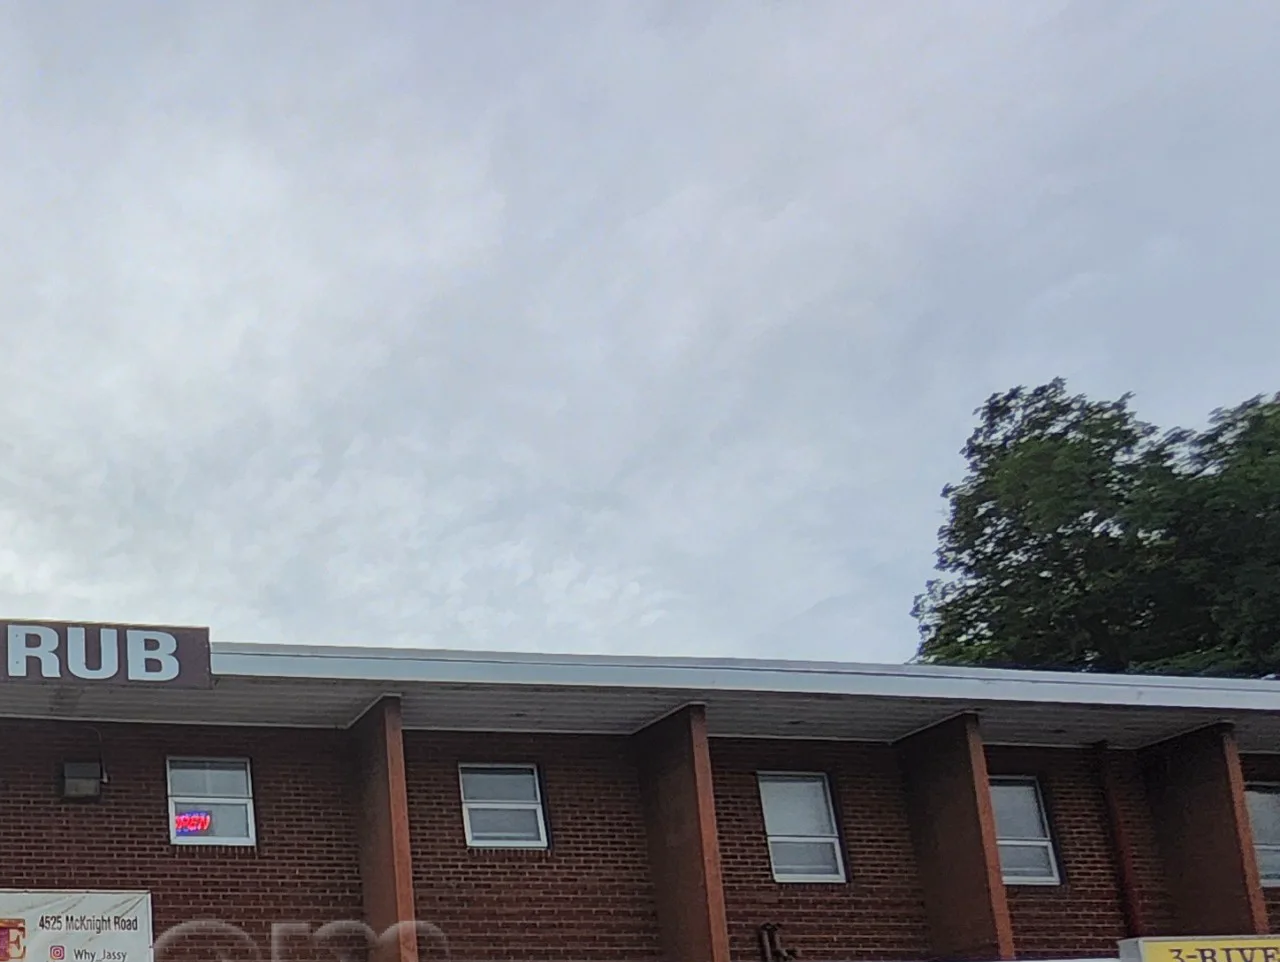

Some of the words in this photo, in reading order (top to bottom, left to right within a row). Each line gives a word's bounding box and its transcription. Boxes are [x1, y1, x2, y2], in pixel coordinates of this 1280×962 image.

[7, 624, 180, 682] RUB
[39, 914, 63, 931] 4525
[65, 915, 112, 934] McKnight
[114, 915, 138, 931] Road
[73, 948, 128, 962] Why_Jassy
